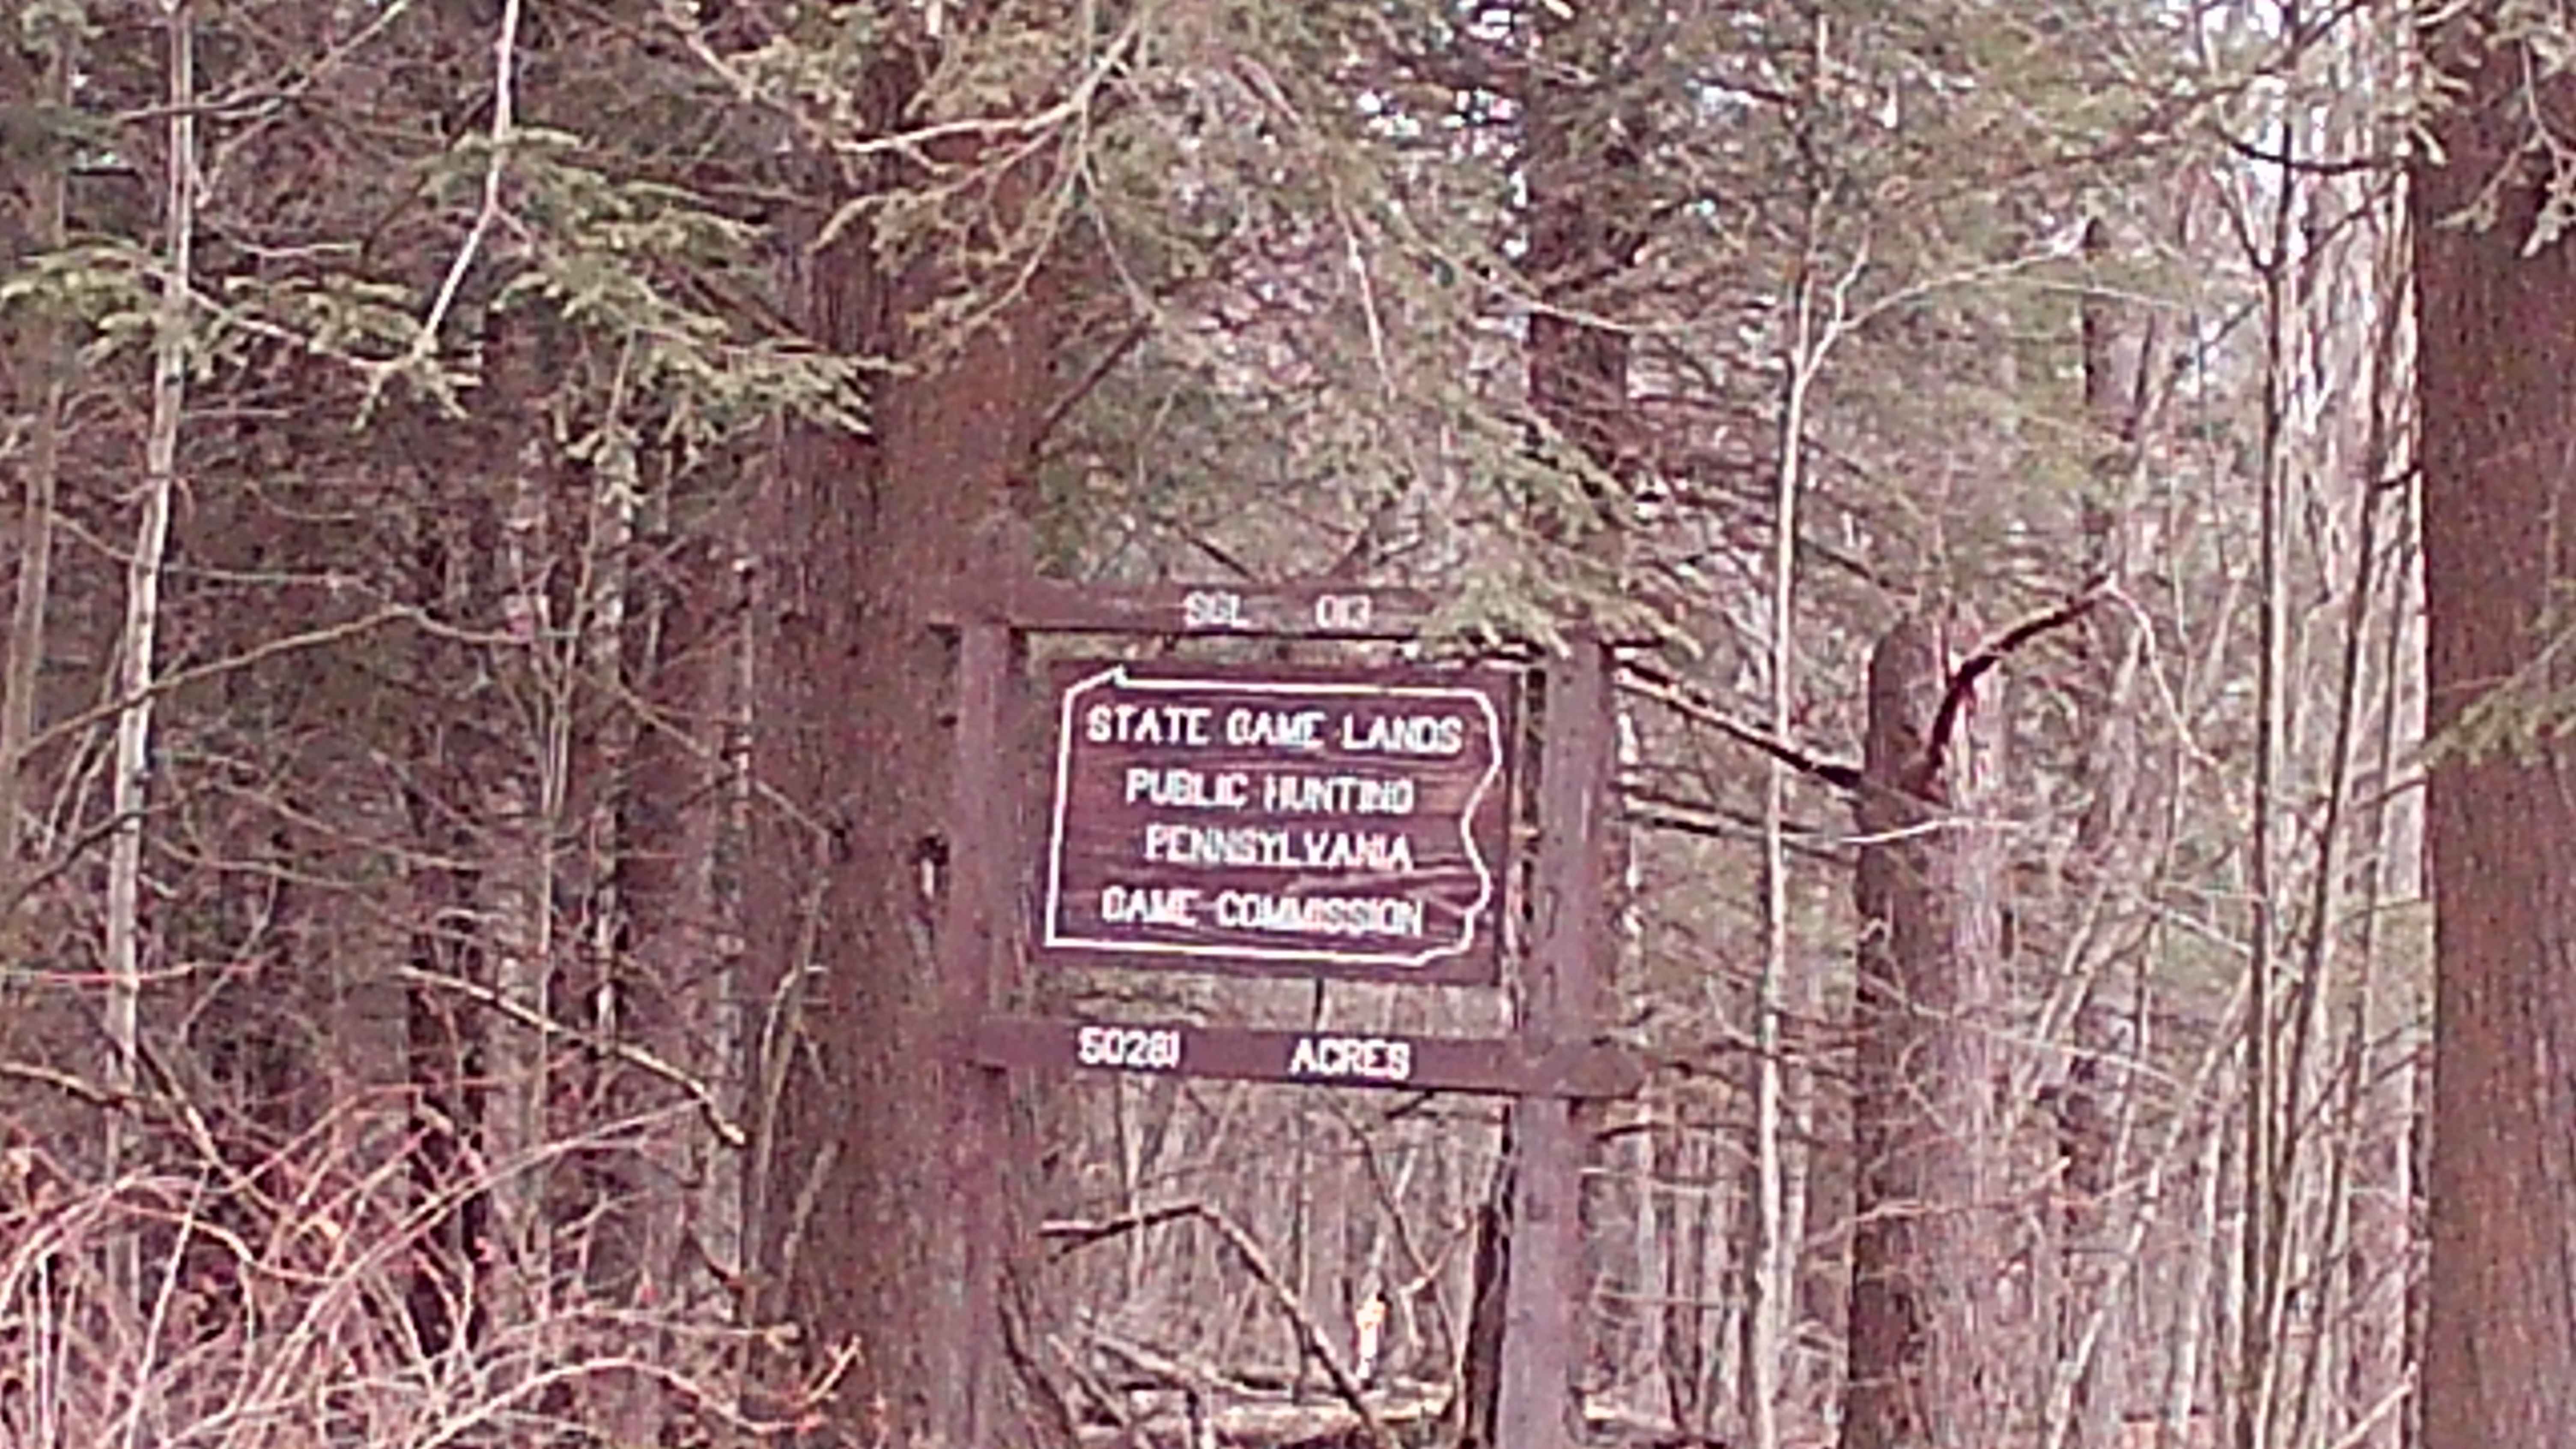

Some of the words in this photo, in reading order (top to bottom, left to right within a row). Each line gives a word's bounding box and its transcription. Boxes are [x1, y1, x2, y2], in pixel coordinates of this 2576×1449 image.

[1086, 704, 1213, 746] STATE
[1226, 707, 1327, 749] GAME
[1341, 712, 1464, 754] LANDS
[1126, 768, 1249, 808] PUBLIC
[1264, 774, 1413, 814] HUNTING
[1144, 823, 1414, 872] PENNSYLVANIA
[1101, 885, 1201, 926] GAME
[1215, 889, 1424, 936] COMMISSION
[1077, 1026, 1180, 1068] 50281
[1288, 1038, 1410, 1080] ACRES
